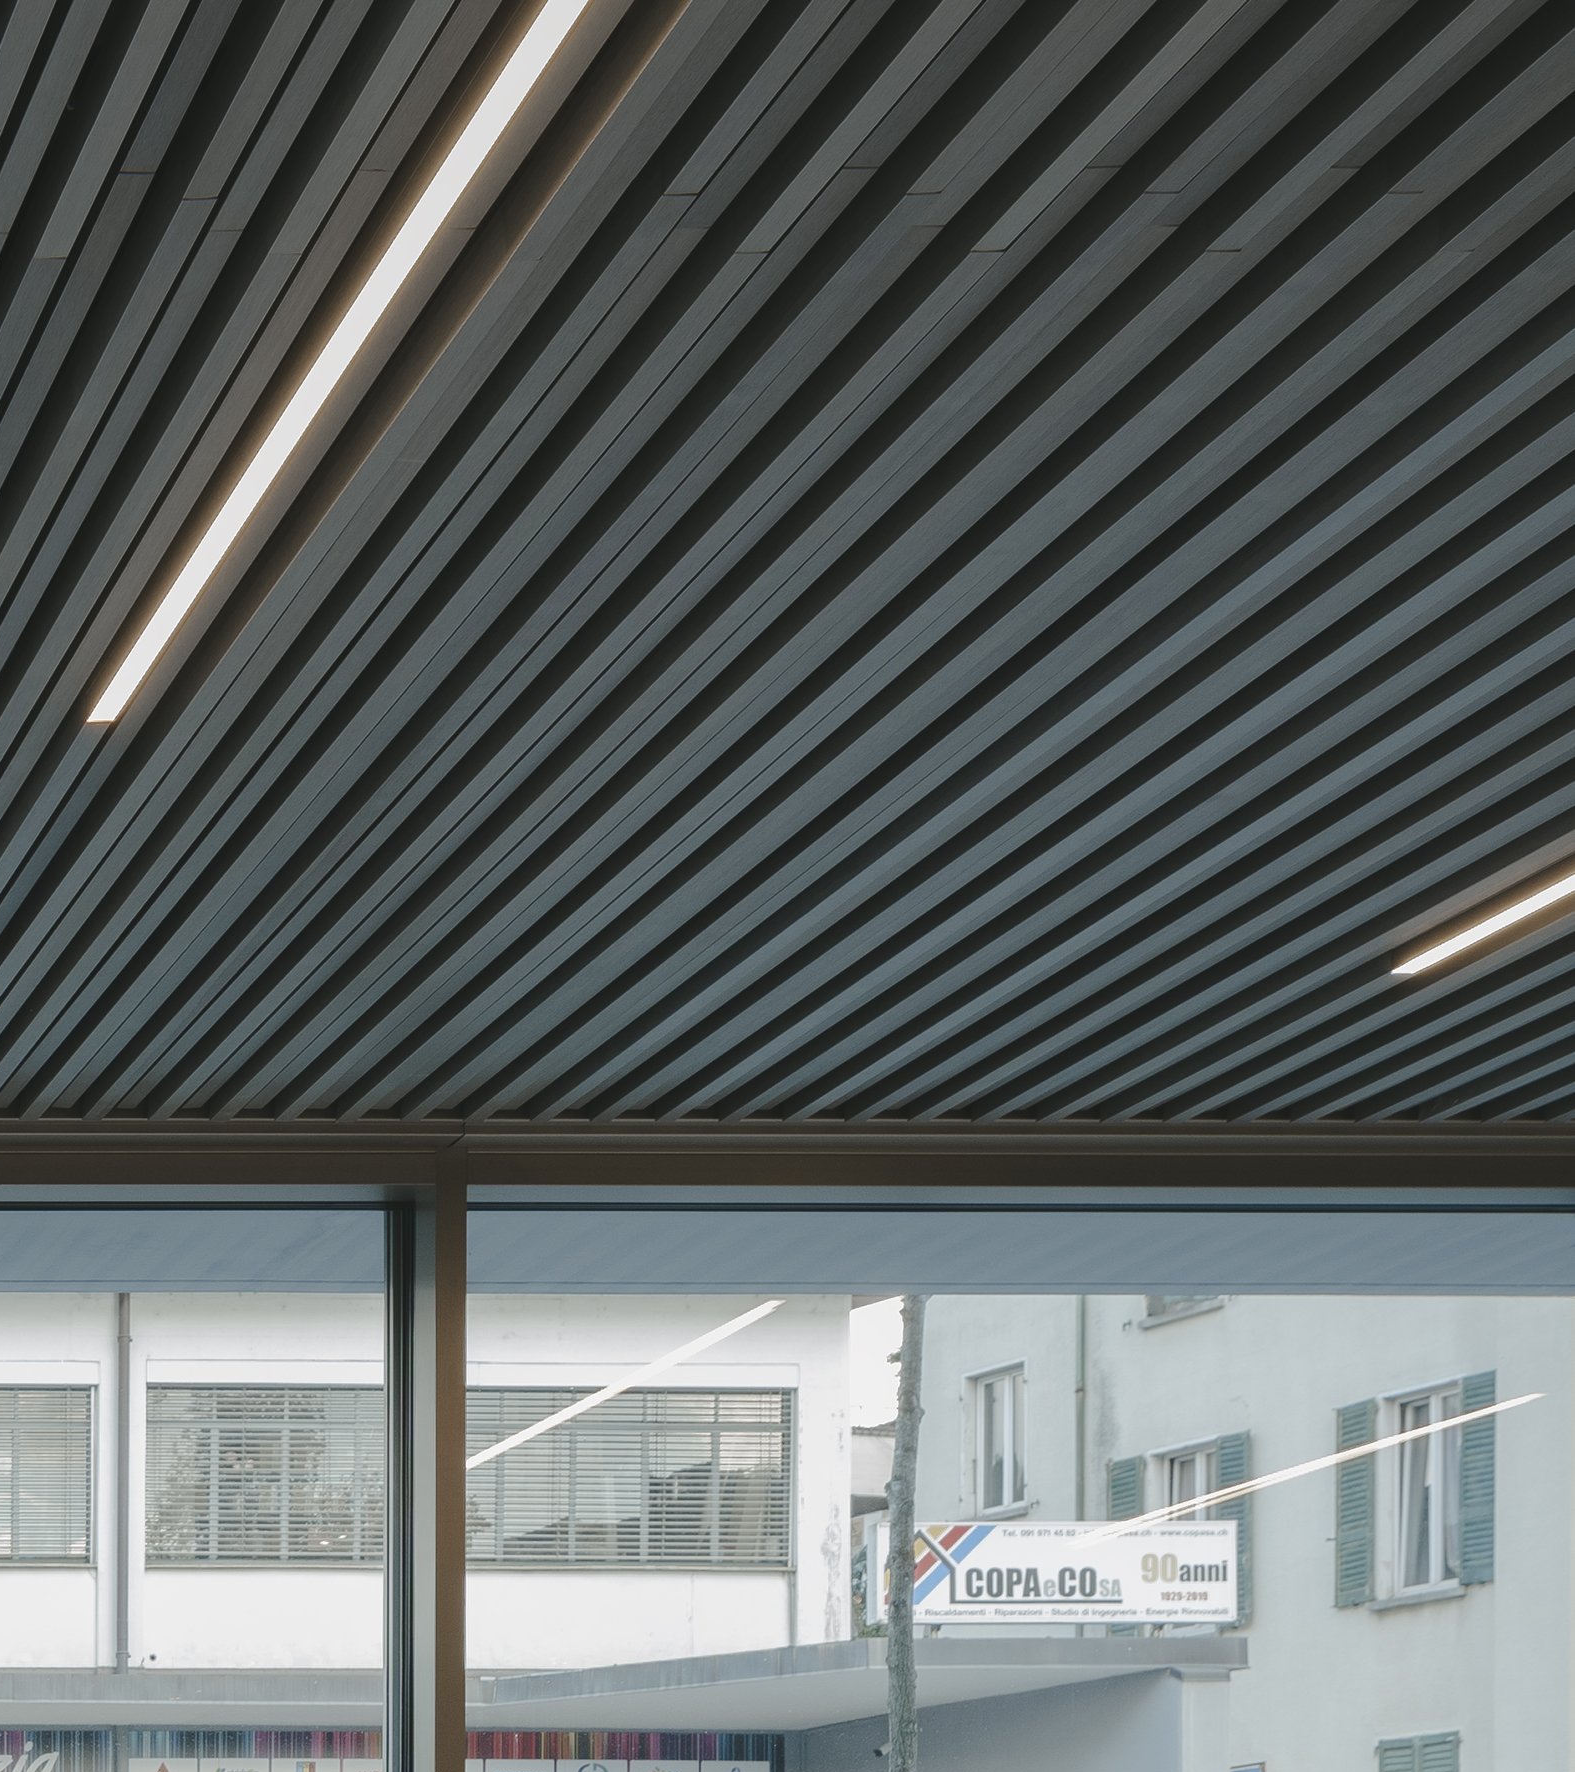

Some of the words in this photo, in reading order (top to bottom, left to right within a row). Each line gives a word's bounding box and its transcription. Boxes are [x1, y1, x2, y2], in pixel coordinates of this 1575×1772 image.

[1001, 1529, 1018, 1537] Tel.
[1020, 1529, 1035, 1537] 091
[1037, 1529, 1051, 1537] 971
[1053, 1529, 1064, 1537] 45
[924, 1608, 987, 1616] Riscaldamenti
[994, 1608, 1043, 1617] Riparazioni
[1051, 1607, 1080, 1616] Studio
[1091, 1607, 1138, 1617] Ingegneria
